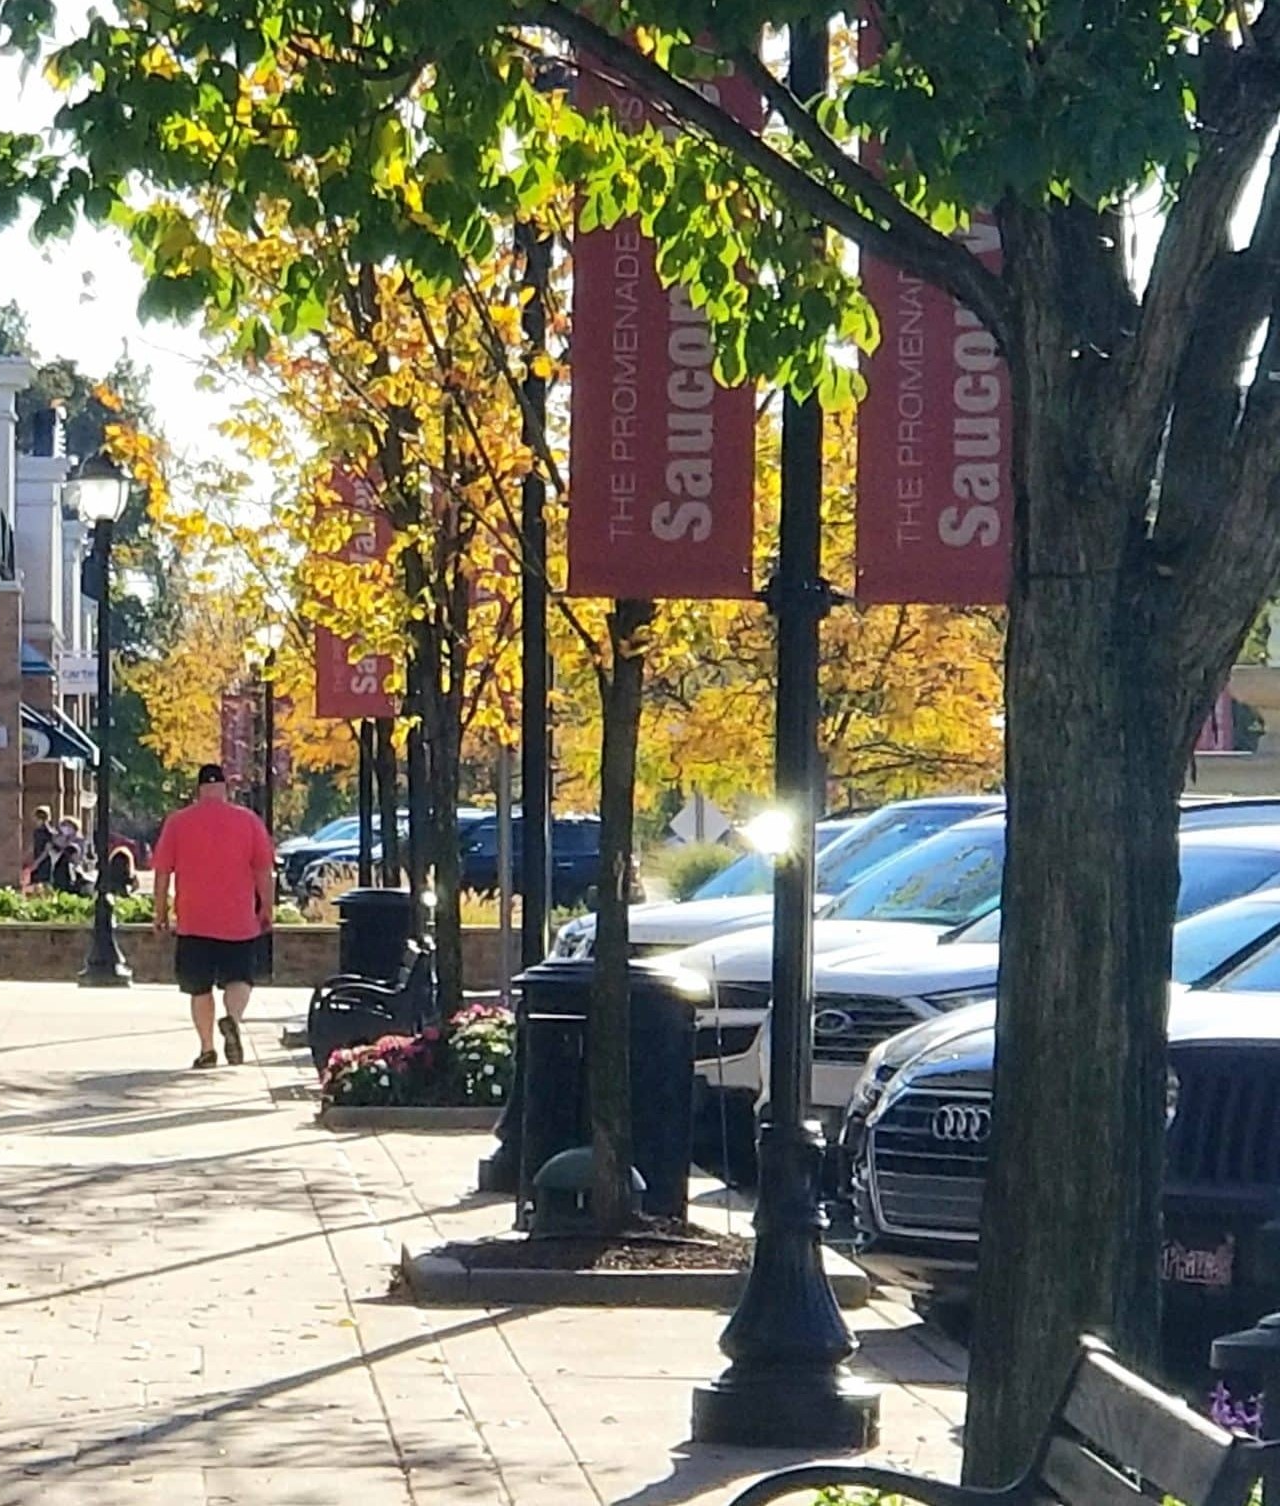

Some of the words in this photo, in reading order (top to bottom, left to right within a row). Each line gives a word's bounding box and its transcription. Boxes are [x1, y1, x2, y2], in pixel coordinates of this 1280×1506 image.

[611, 232, 640, 461] PROMENADE
[897, 270, 924, 466] PROMENA
[609, 473, 636, 543] THE
[897, 478, 923, 548] THE
